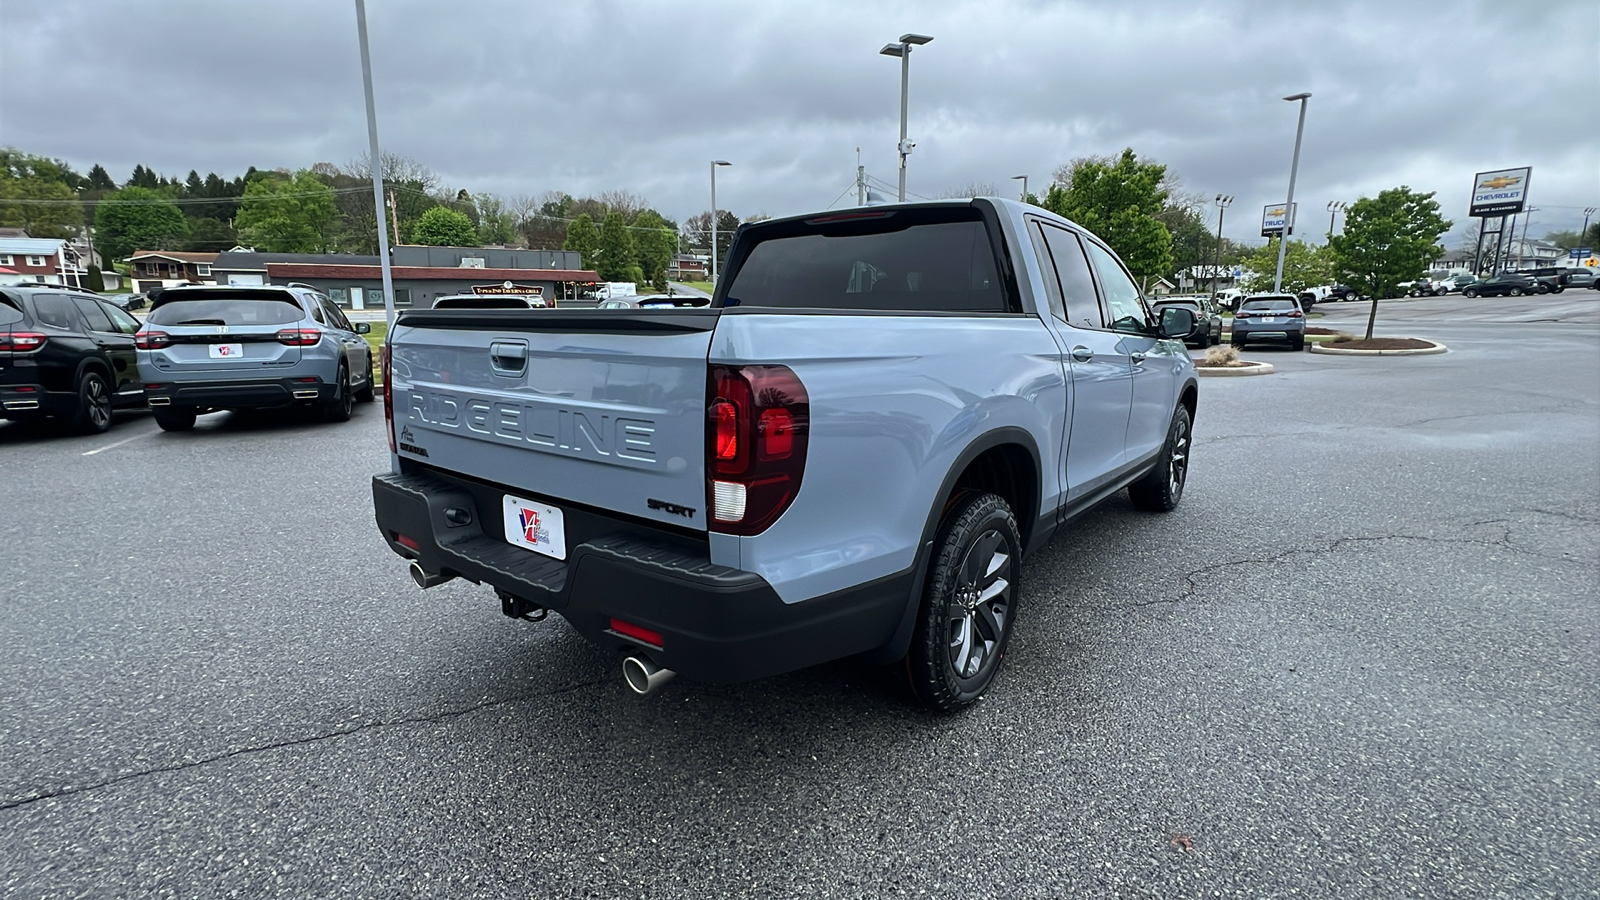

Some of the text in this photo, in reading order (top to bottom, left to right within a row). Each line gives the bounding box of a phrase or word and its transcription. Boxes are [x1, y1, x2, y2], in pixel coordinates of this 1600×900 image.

[1476, 192, 1519, 201] CHEVROLET
[407, 390, 657, 463] RIDGELINE
[647, 498, 696, 518] SPORT
